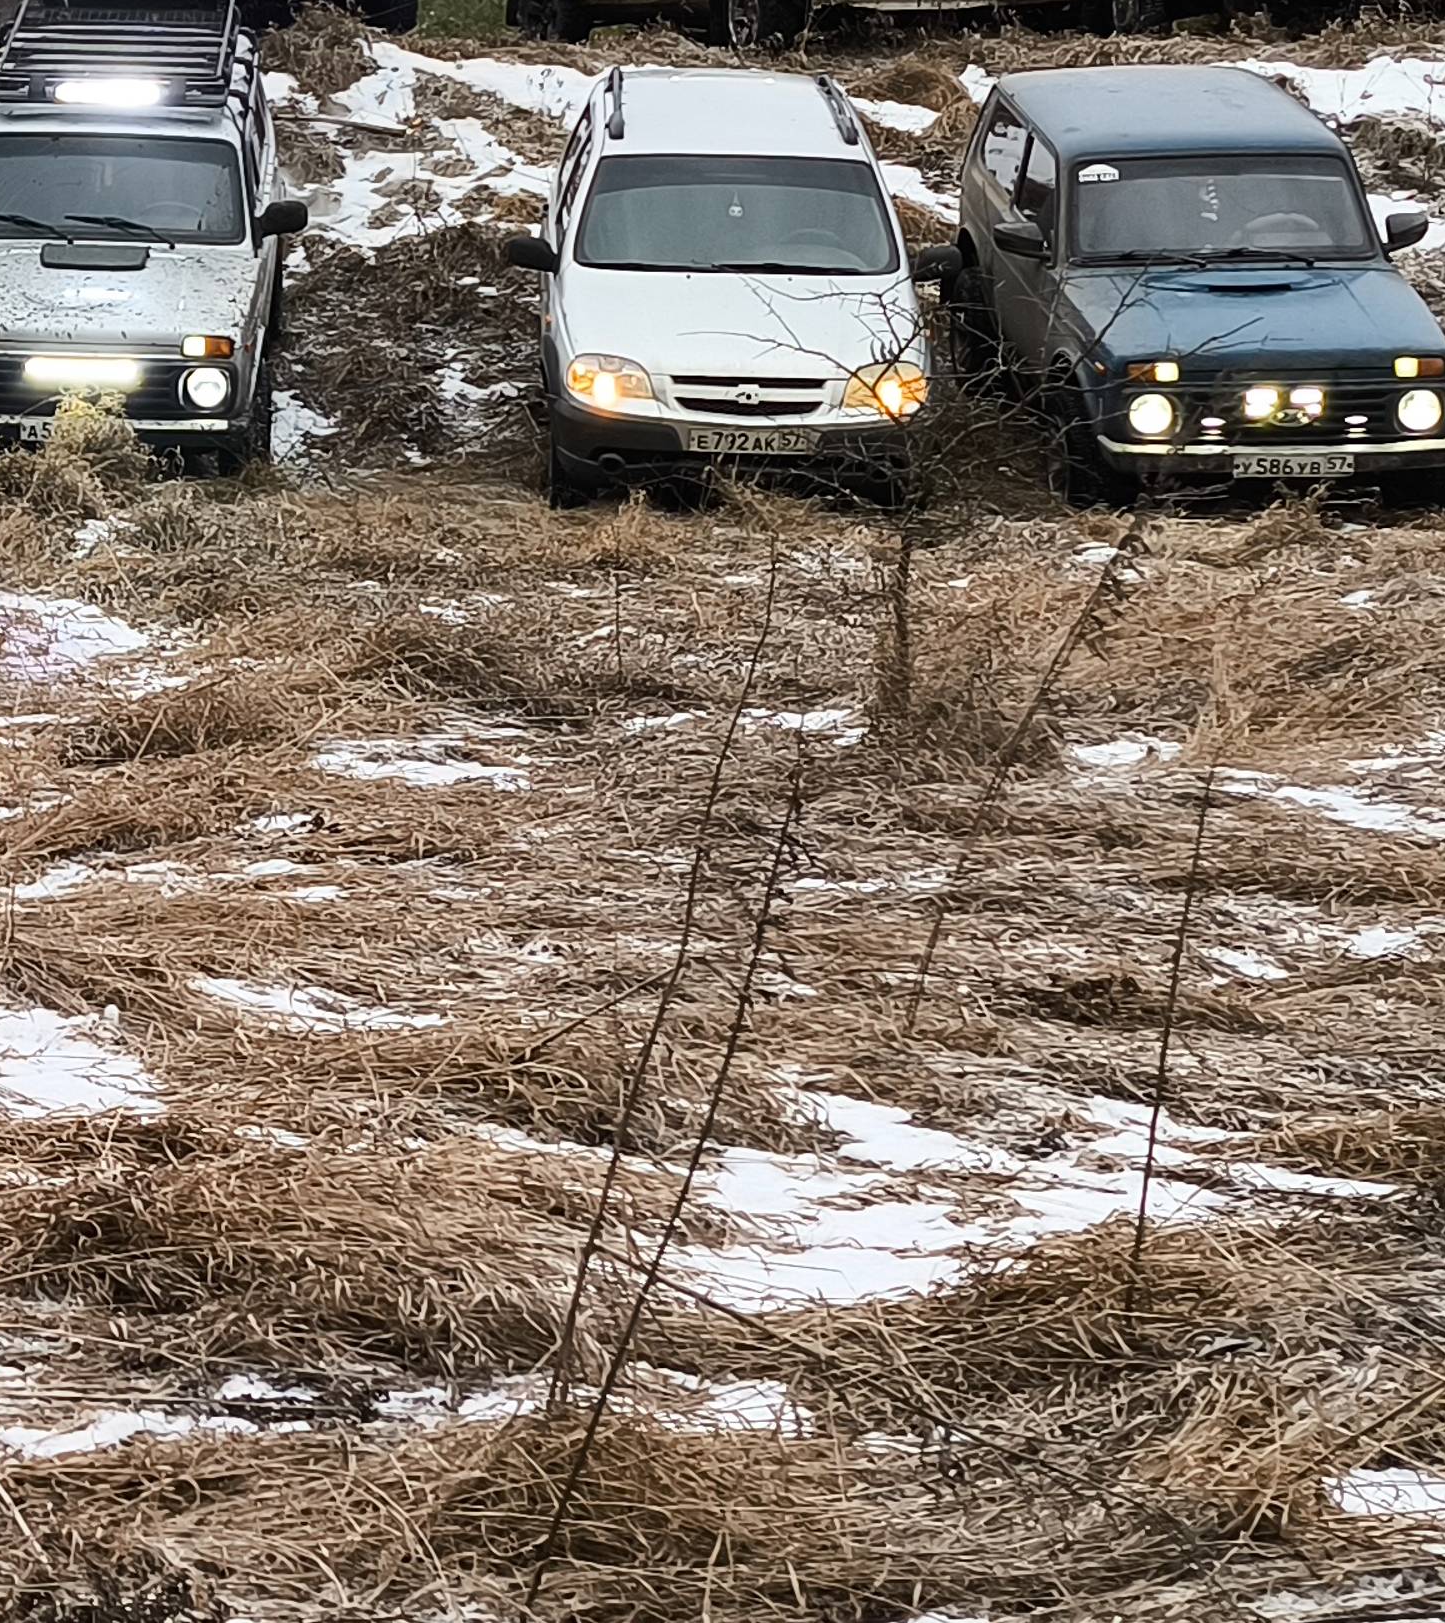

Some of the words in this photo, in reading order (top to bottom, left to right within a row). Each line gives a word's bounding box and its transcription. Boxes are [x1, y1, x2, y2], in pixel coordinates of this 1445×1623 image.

[697, 431, 775, 452] Е792АК
[1241, 458, 1321, 475] У586УВ
[1327, 457, 1347, 470] 57
